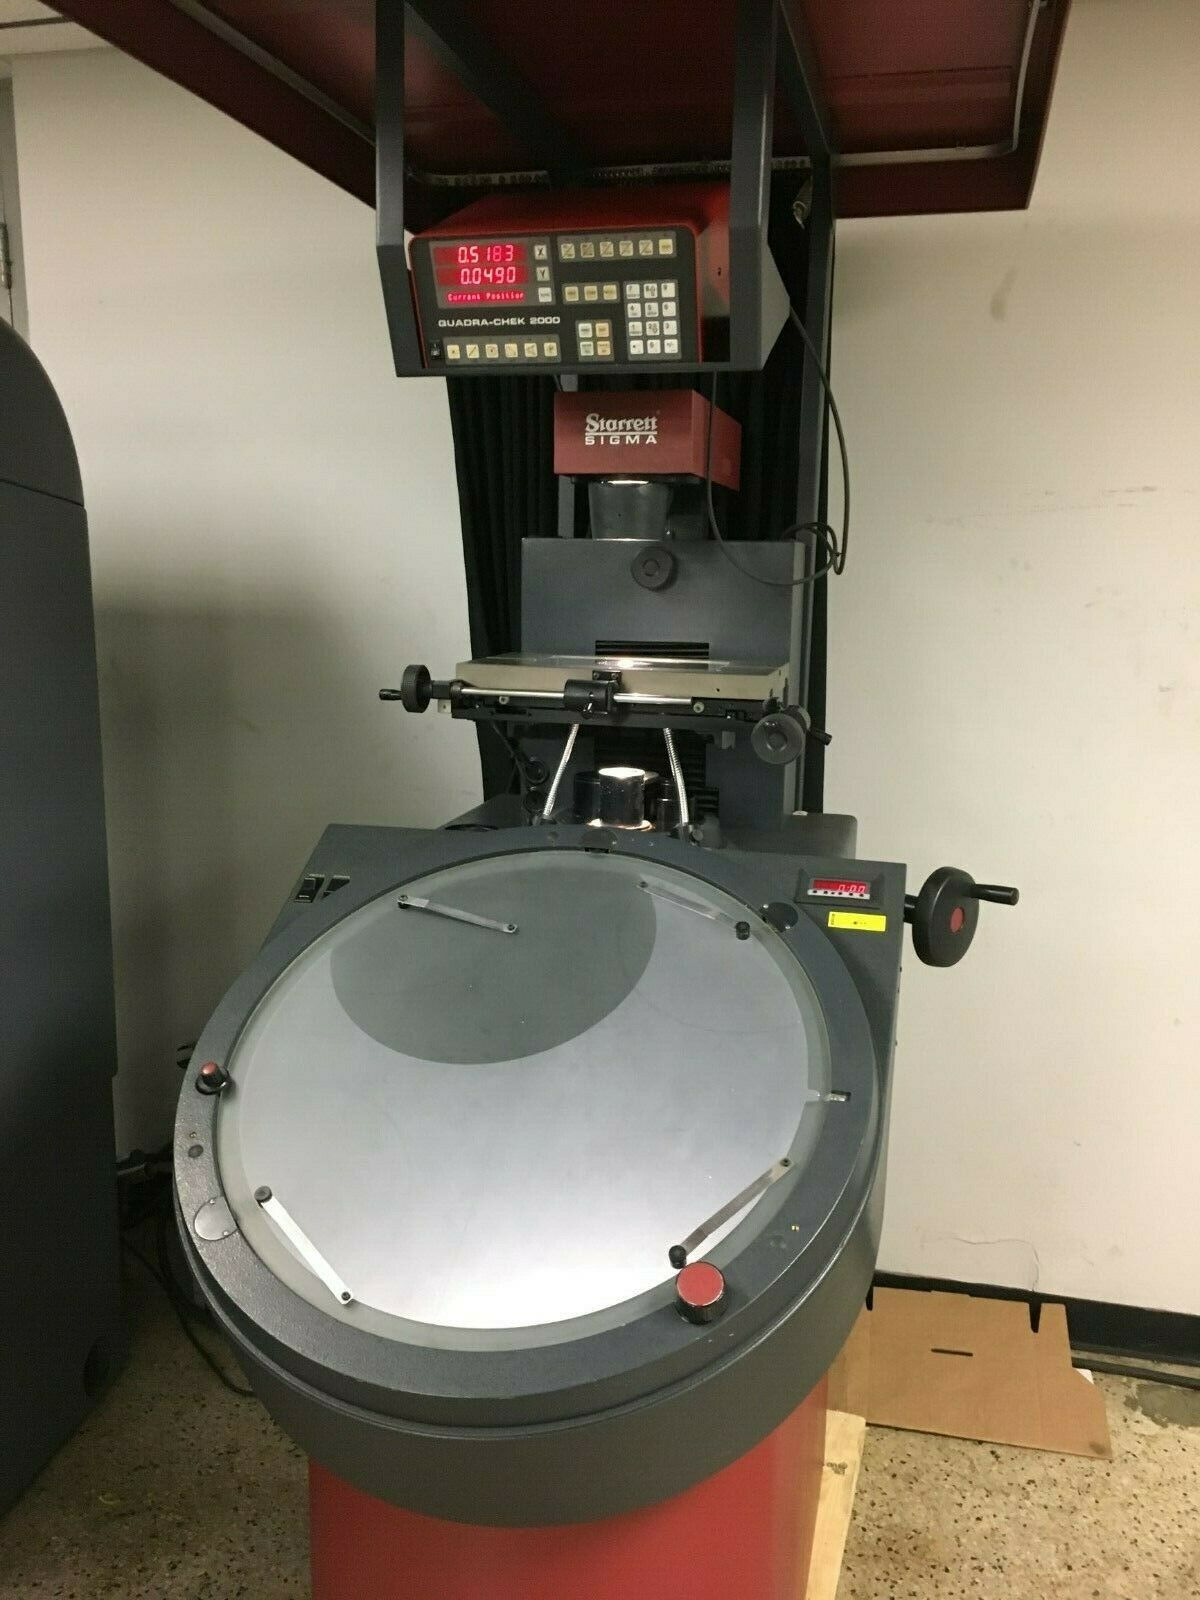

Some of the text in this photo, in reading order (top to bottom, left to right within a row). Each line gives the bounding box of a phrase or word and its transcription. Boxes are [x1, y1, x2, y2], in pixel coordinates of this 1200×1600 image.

[458, 244, 514, 264] 0.5183
[460, 266, 516, 285] 0.0490
[438, 316, 561, 328] QUADRA-CHEK 2000
[585, 412, 658, 432] Starrett
[585, 435, 658, 446] SIGMA
